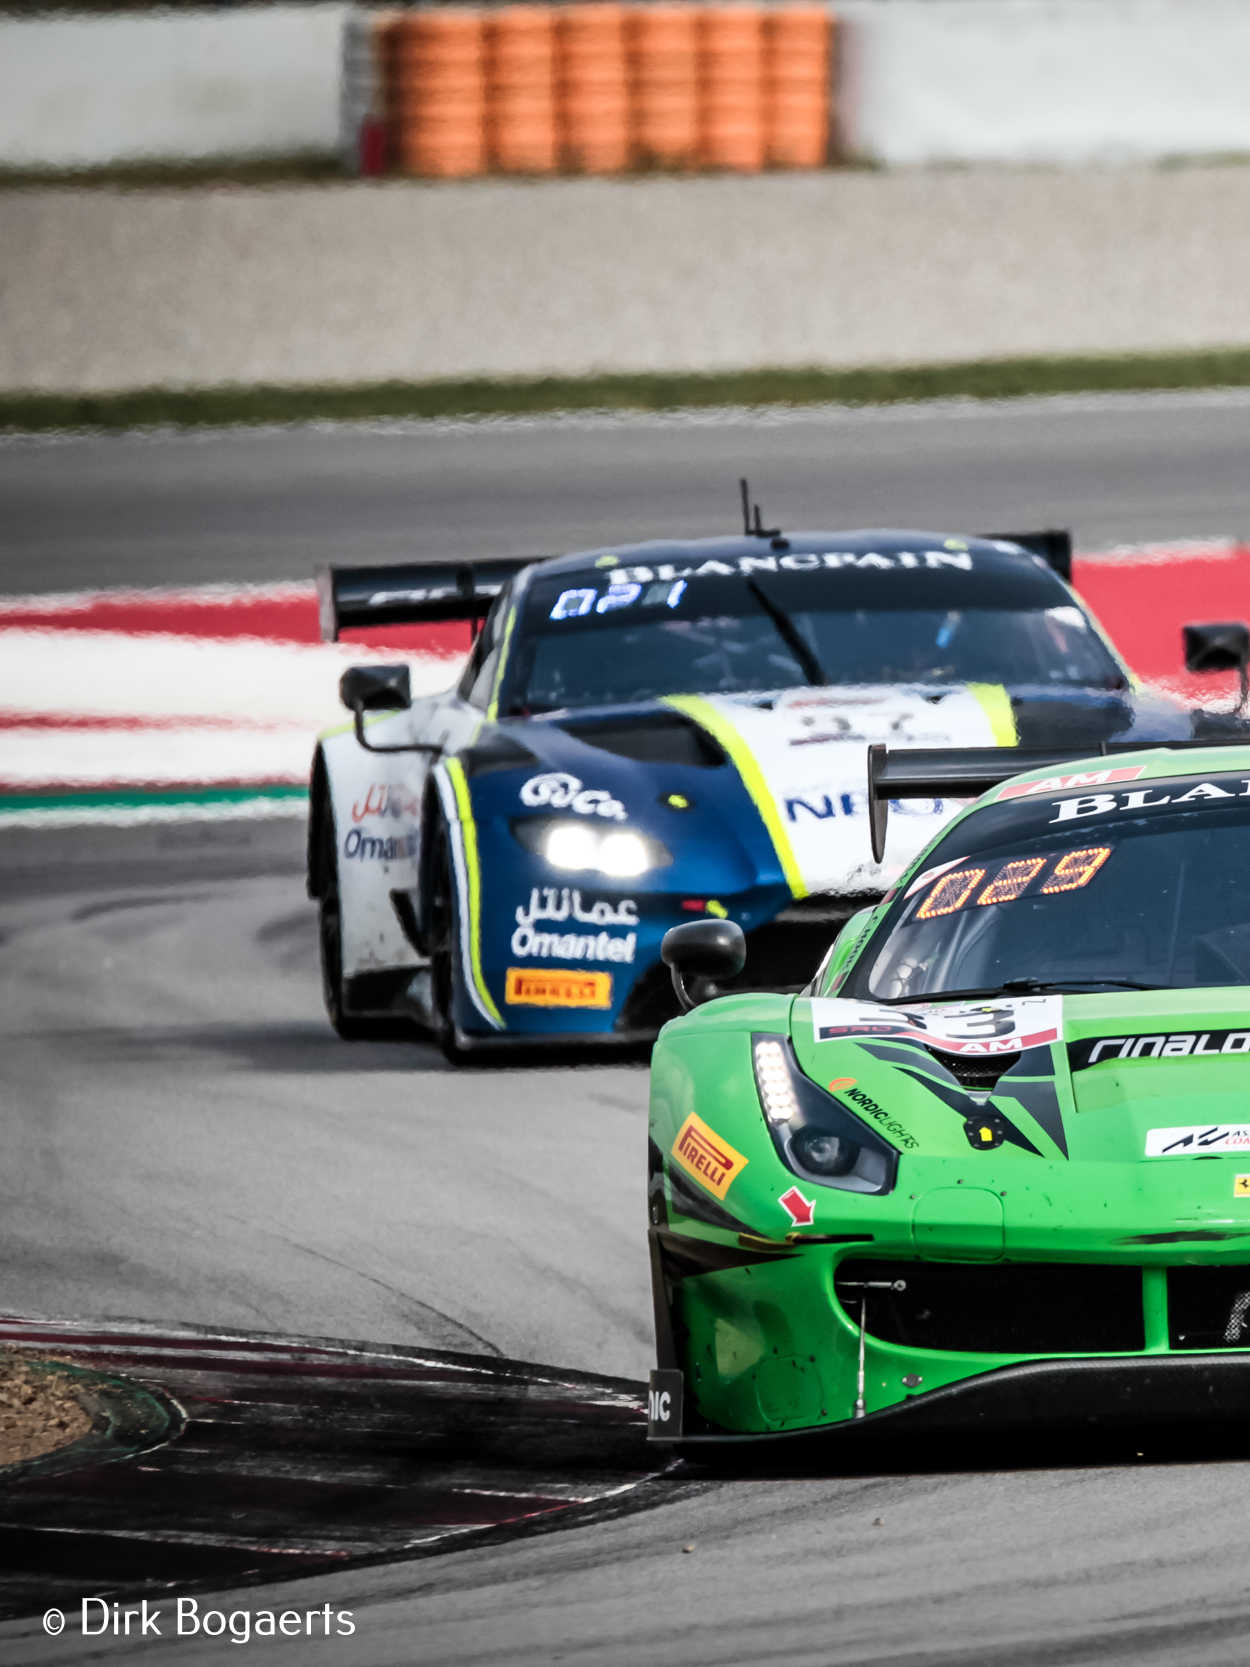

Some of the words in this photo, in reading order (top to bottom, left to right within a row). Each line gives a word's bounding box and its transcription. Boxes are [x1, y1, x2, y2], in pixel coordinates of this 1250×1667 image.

[1027, 769, 1113, 793] AM
[915, 847, 1111, 919] 029
[511, 927, 637, 963] Omantel
[959, 1037, 1024, 1054] AM
[679, 1125, 734, 1186] PIRELLI
